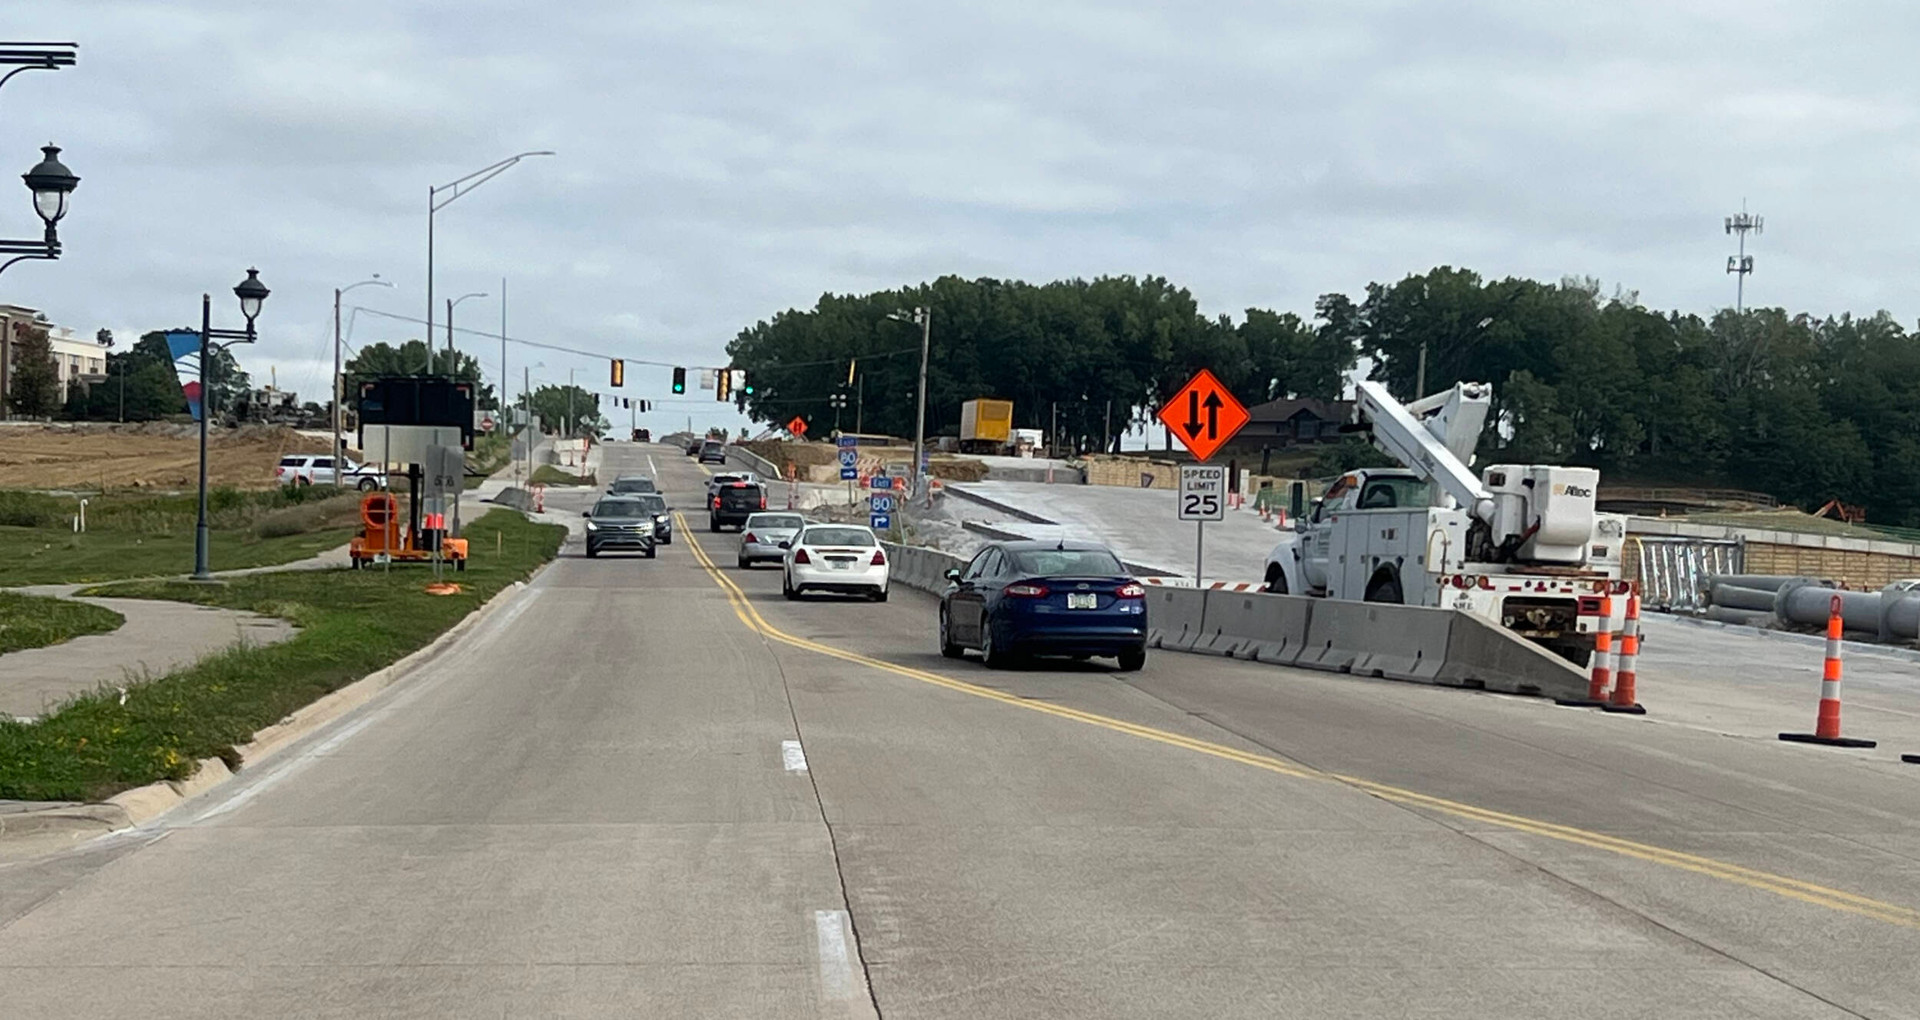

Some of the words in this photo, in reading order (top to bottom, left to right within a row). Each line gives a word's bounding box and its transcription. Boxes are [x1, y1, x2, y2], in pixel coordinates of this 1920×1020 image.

[840, 451, 856, 464] 80
[1183, 469, 1221, 479] SPEED
[1186, 481, 1217, 491] LIMIT
[872, 497, 890, 511] 80
[1184, 494, 1219, 515] 25
